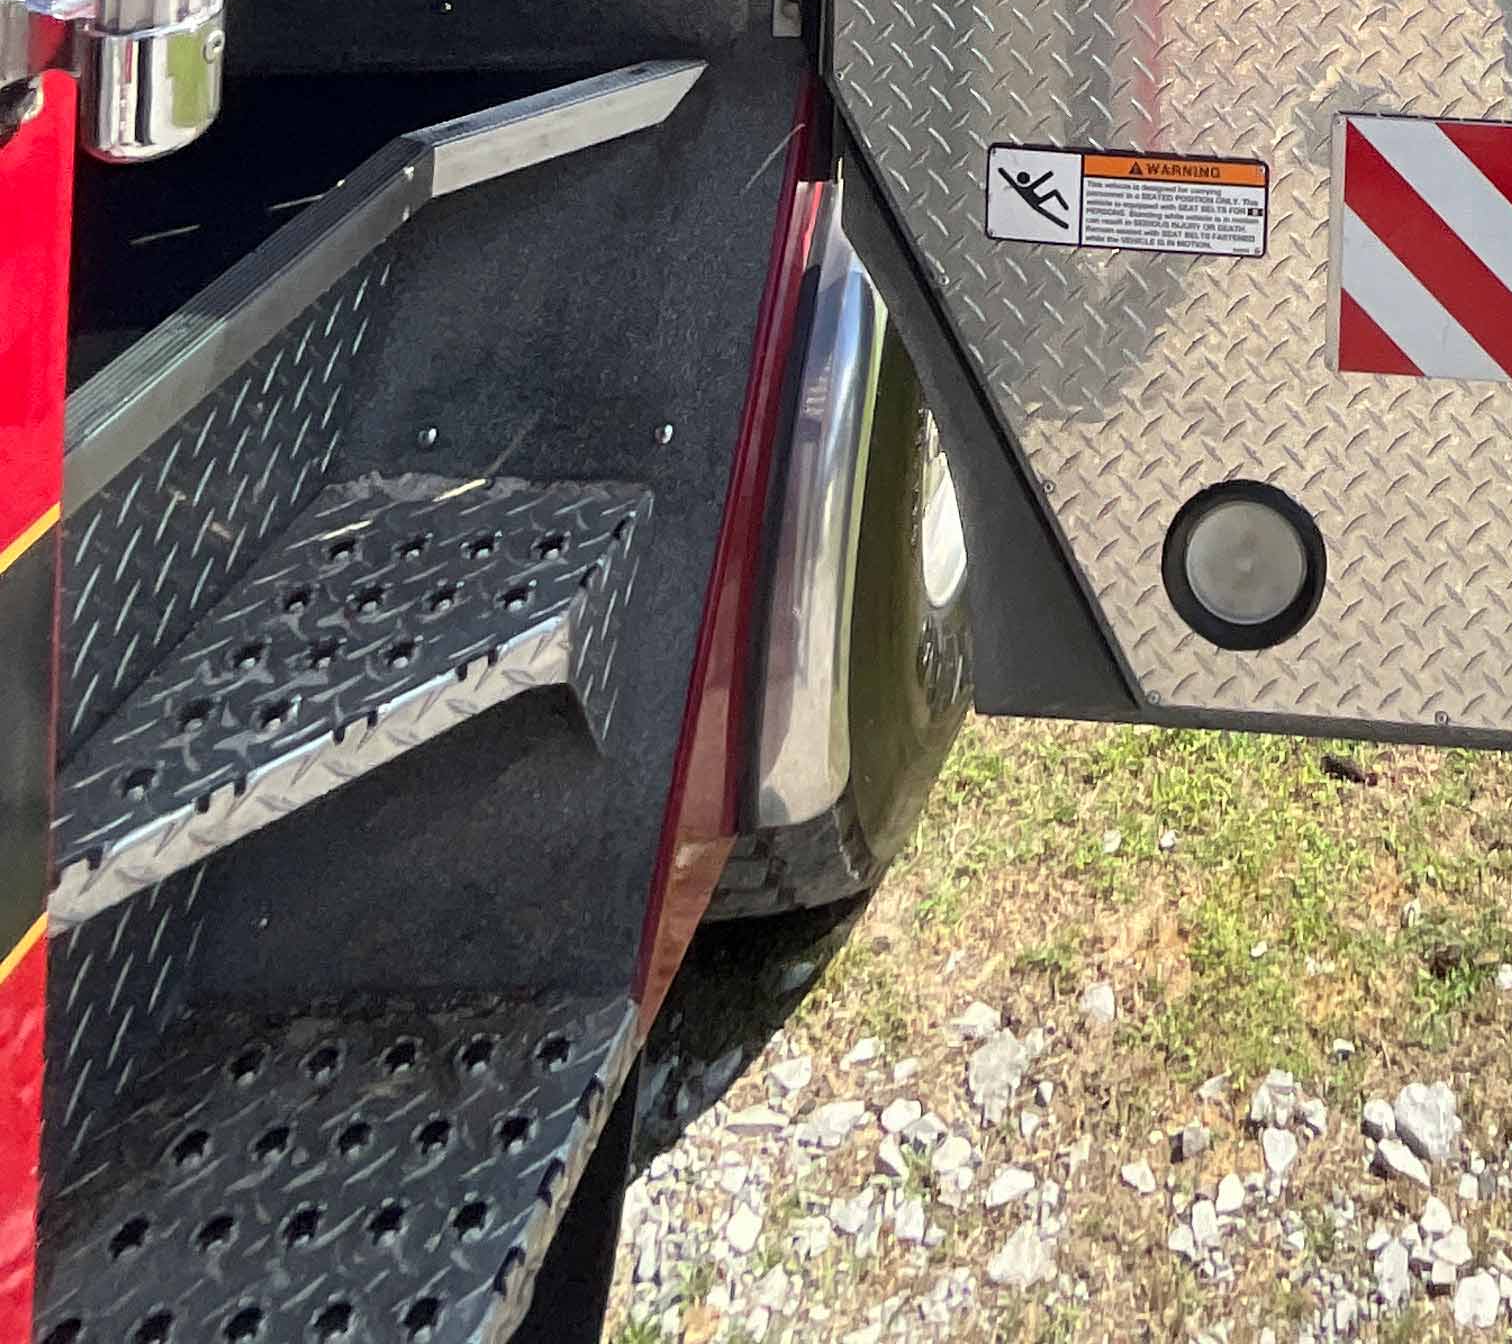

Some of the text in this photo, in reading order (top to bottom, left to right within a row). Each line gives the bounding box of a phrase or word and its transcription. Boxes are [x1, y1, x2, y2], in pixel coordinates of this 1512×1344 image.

[1146, 163, 1220, 178] WARNING
[1142, 193, 1173, 201] SEATED
[1175, 195, 1213, 203] POSITION
[1178, 204, 1198, 212] SEAT
[1134, 219, 1169, 227] SERIOUS
[1171, 221, 1200, 229] INJURY
[1184, 231, 1209, 239] BELTS
[1212, 233, 1255, 241] FASTENED
